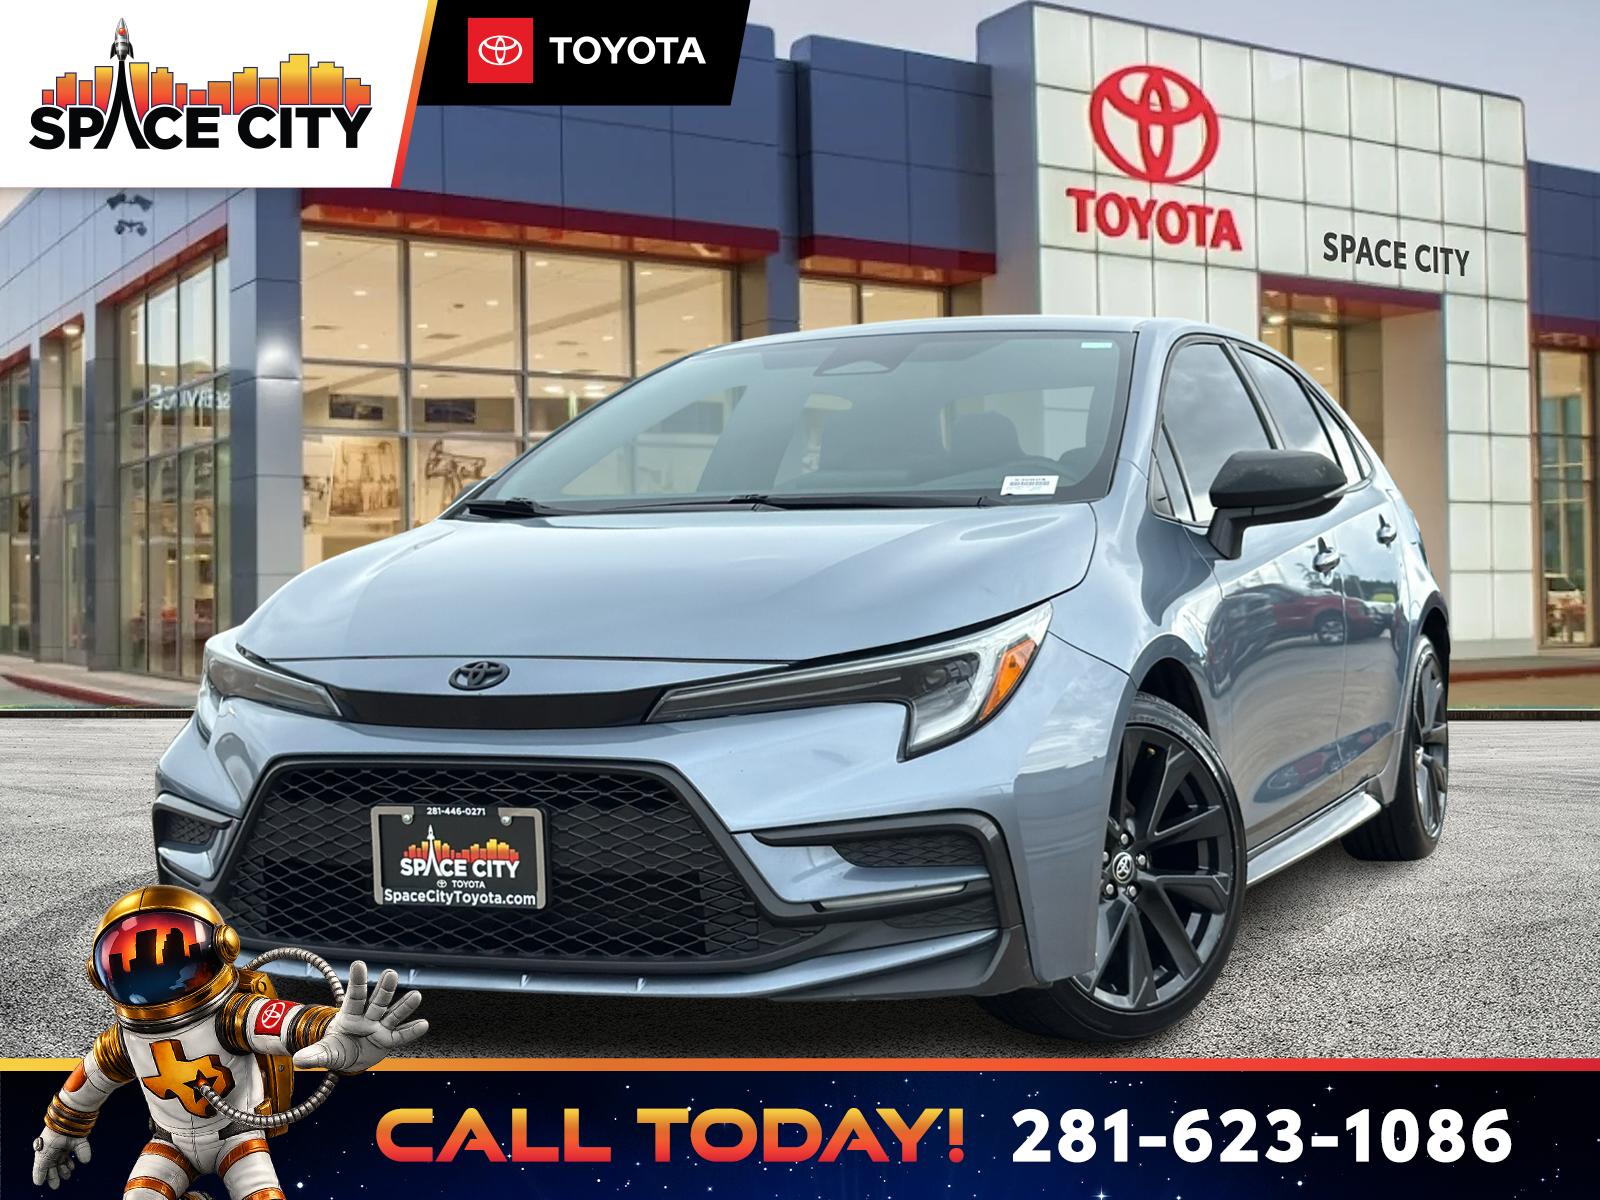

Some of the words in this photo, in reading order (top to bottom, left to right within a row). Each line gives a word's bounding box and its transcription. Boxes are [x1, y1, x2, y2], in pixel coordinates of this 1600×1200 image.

[1066, 187, 1242, 252] TOYOTA
[1322, 231, 1408, 271] SPACE
[1414, 243, 1471, 277] CITY
[426, 806, 486, 816] 281-446-0271
[400, 856, 468, 878] SPACE
[471, 859, 520, 879] CITY
[451, 879, 486, 889] TOYOTA
[384, 888, 536, 906] SpaceCityToyota.com
